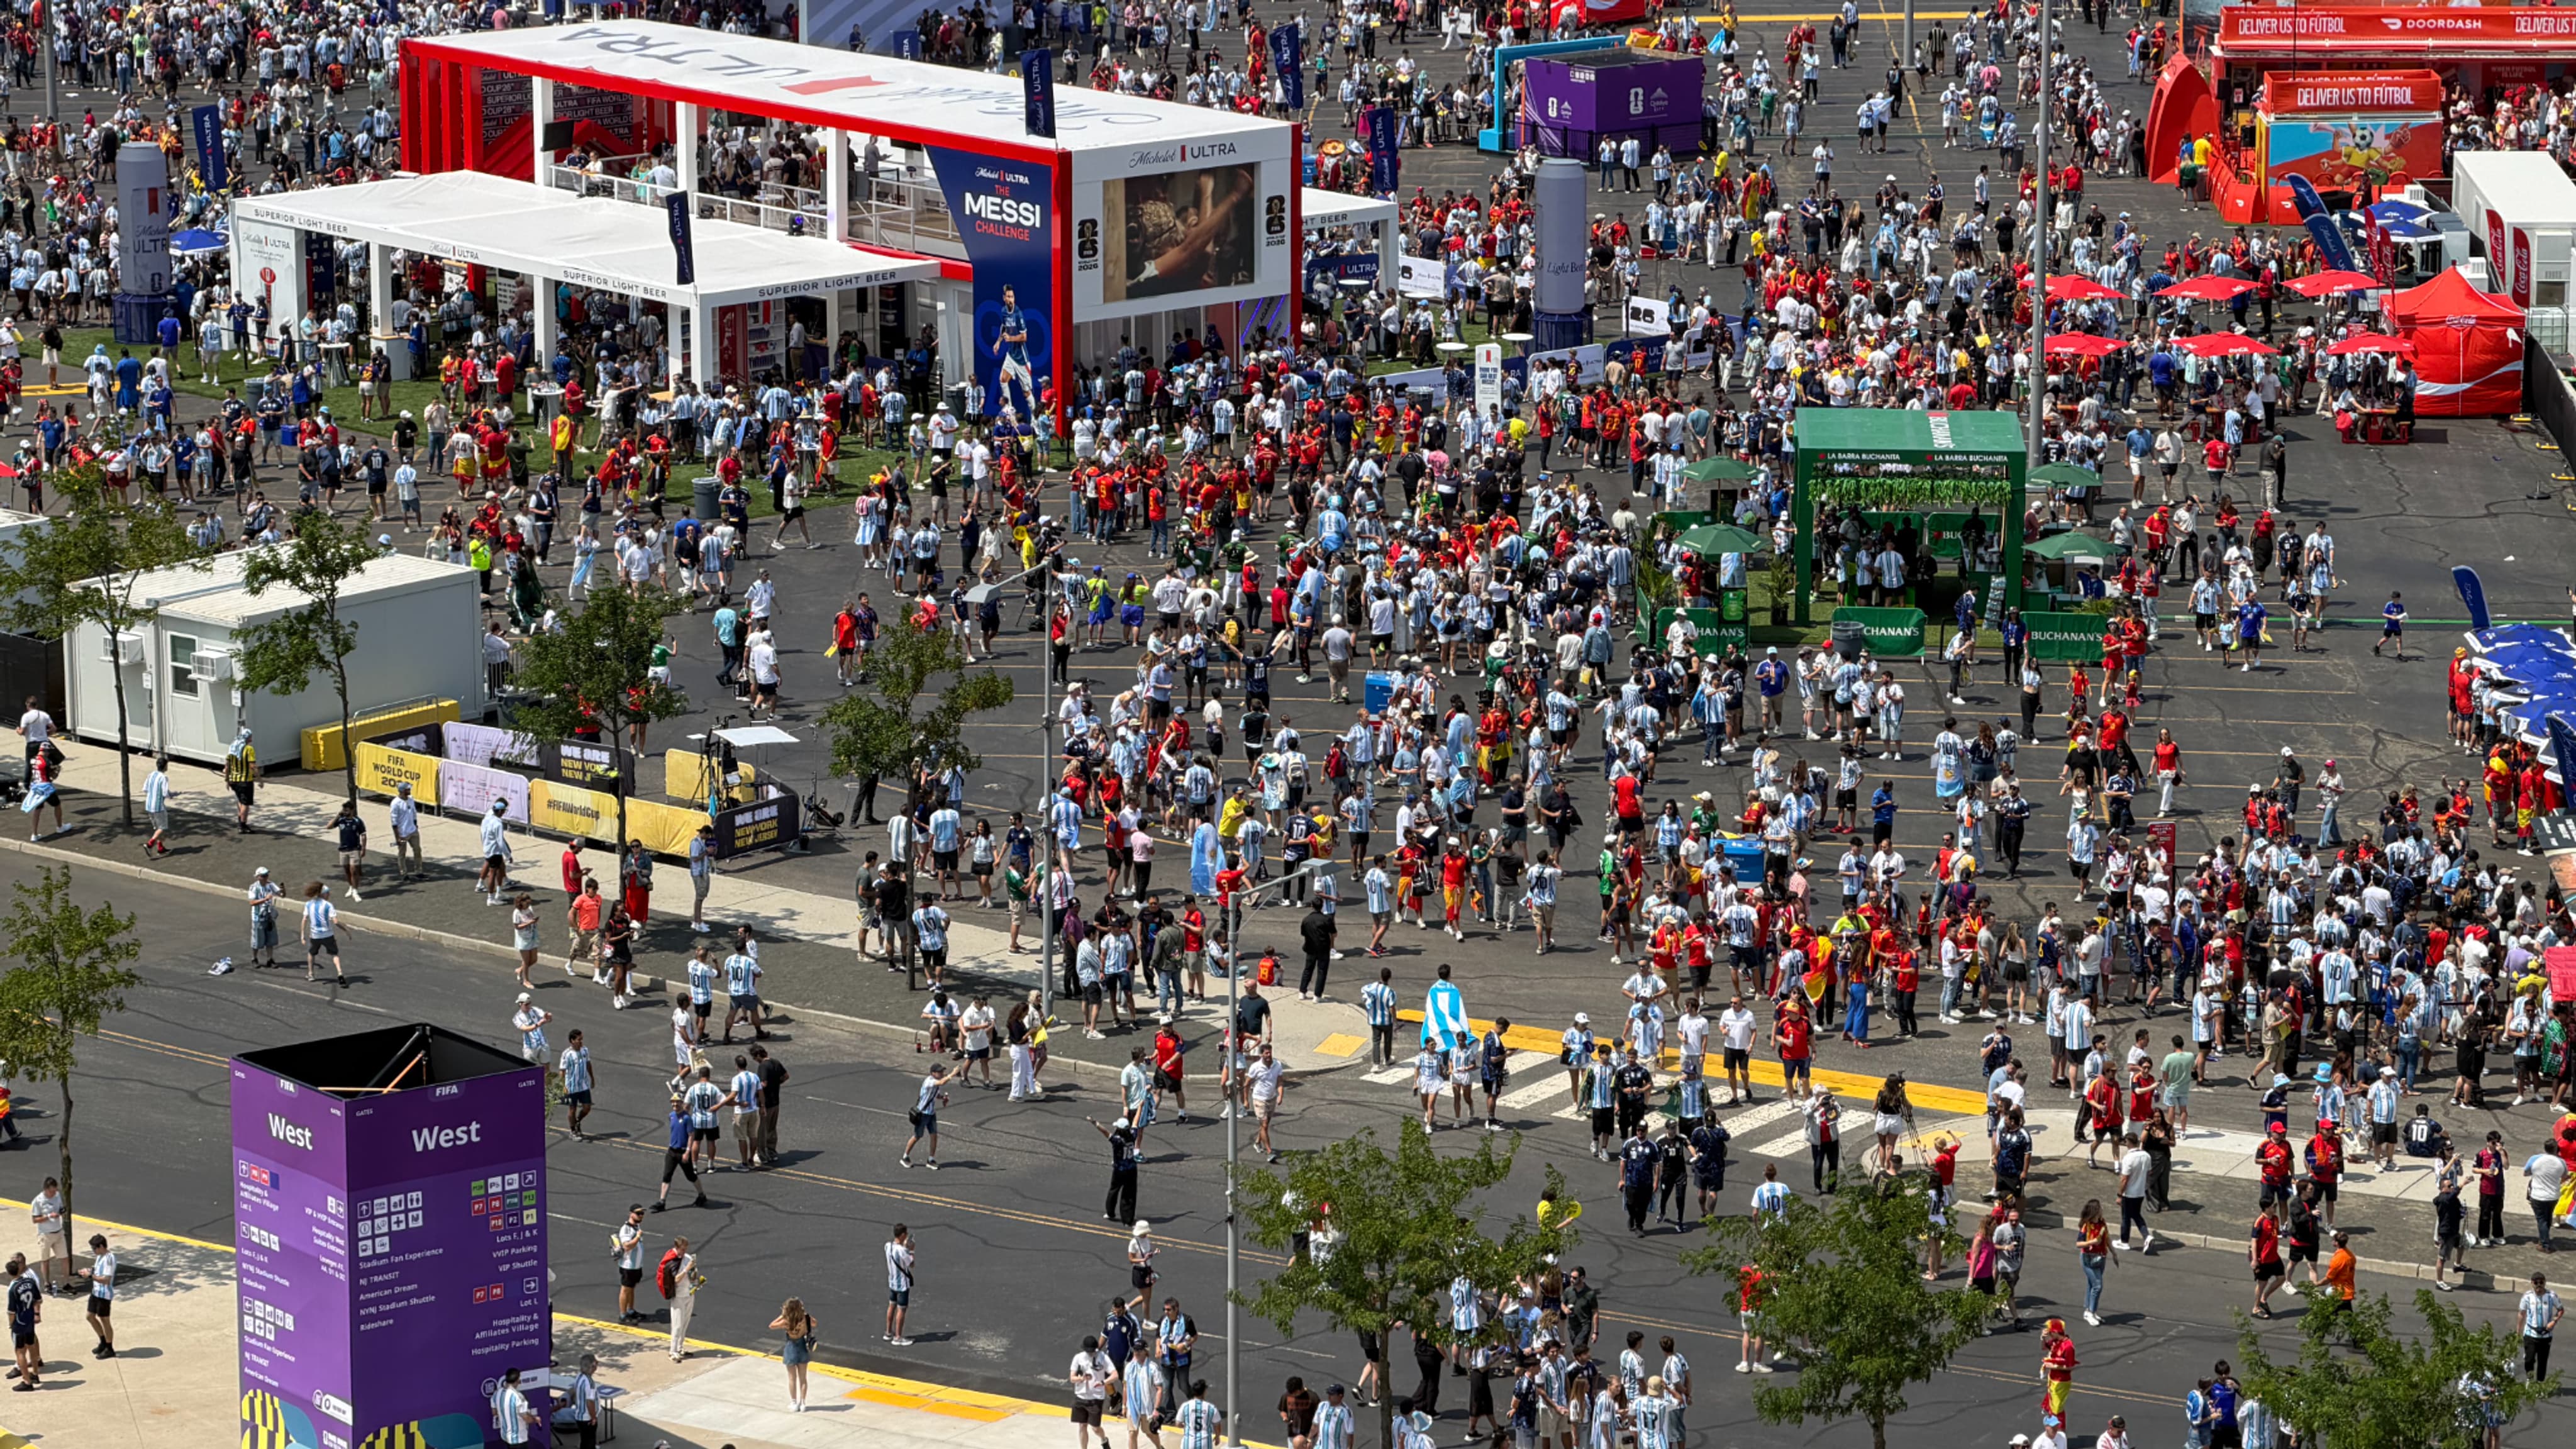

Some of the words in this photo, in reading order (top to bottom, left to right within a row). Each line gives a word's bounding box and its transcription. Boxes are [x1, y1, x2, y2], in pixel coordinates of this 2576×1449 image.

[2238, 17, 2277, 35] DELIVER
[2279, 17, 2294, 33] US
[2296, 18, 2307, 33] TO
[2309, 14, 2346, 33] FÚTBOL
[2406, 18, 2482, 29] DOORDASH
[2516, 16, 2555, 33] DELIVER
[2557, 17, 2568, 33] US
[558, 27, 811, 79] ULTRA
[1280, 32, 1291, 65] ULTRA
[1033, 58, 1041, 93] ULTRA
[487, 84, 501, 92] CUP
[2297, 87, 2340, 107] DELIVER
[2342, 87, 2355, 105] US
[2357, 87, 2371, 105] TO
[2373, 83, 2415, 105] FÚTBOL
[487, 95, 521, 104] SUPERIOR
[602, 95, 627, 103] WORLD
[574, 109, 594, 117] LIGHT
[602, 116, 628, 125] WORLD
[203, 114, 212, 146] ULTRA
[1129, 148, 1176, 169] Michelob
[1191, 143, 1236, 158] ULTRA
[1005, 174, 1030, 185] ULTRA
[995, 185, 1010, 196] THE
[964, 192, 1041, 228] MESSI
[254, 208, 295, 224] SUPERIOR
[298, 216, 323, 230] LIGHT
[326, 221, 348, 233] BEER
[675, 201, 684, 236] ULTRA
[1320, 213, 1348, 224] BEER
[975, 220, 1030, 242] CHALLENGE
[269, 239, 291, 250] ULTRA
[457, 249, 479, 260] ULTRA
[1078, 263, 1099, 271] 2026
[1347, 263, 1378, 274] ULTRA
[1547, 261, 1568, 275] Light
[564, 270, 609, 287] SUPERIOR
[612, 279, 640, 292] LIGHT
[643, 286, 667, 299] BEER
[758, 280, 819, 297] SUPERIOR
[824, 275, 861, 289] LIGHT
[866, 270, 897, 283] BEER
[1629, 308, 1655, 323] 26
[889, 400, 899, 411] 10
[1604, 418, 1621, 431] 22
[454, 441, 468, 453] 44
[370, 456, 382, 469] 10
[1861, 453, 1900, 461] BUCHANITA
[1968, 455, 2008, 463] BUCHANITA
[2049, 449, 2057, 462] 5
[921, 540, 931, 552] 10
[1547, 577, 1558, 591] 10
[2031, 631, 2102, 643] BUCHANAN'S
[560, 745, 580, 757] WE
[582, 748, 610, 763] ARE
[1941, 741, 1953, 755] 10
[2003, 741, 2016, 754] 22
[387, 755, 405, 767] FIFA
[561, 758, 582, 770] NEW
[372, 762, 403, 778] WORLD
[404, 770, 421, 781] CUP
[561, 769, 584, 780] NEW
[1194, 777, 1206, 791] 19
[547, 799, 600, 819] #FIFAWorldCup
[735, 810, 753, 826] WE
[735, 826, 755, 838] NEW
[755, 819, 779, 831] YORK
[1292, 824, 1306, 838] 10
[735, 837, 754, 848] NEW
[1250, 831, 1260, 845] 10
[1367, 880, 1376, 894] 10
[1733, 918, 1746, 933] 10
[730, 966, 743, 982] 10
[2330, 965, 2343, 981] 10
[2372, 975, 2380, 991] 11
[280, 1079, 295, 1092] FIFA
[436, 1085, 458, 1097] FIFA
[518, 1080, 535, 1088] GATES
[696, 1094, 711, 1109] 10
[356, 1108, 374, 1117] GATES
[269, 1113, 313, 1150] West
[411, 1120, 481, 1152] West
[2411, 1123, 2428, 1142] 10
[240, 1182, 264, 1197] Hospitality
[240, 1191, 262, 1204] Affiliates
[263, 1199, 279, 1211] Village
[1765, 1195, 1781, 1212] 10
[312, 1226, 335, 1242] Hospitality
[497, 1235, 511, 1243] Lots
[359, 1259, 389, 1269] Stadium
[391, 1253, 404, 1262] Fan
[405, 1248, 443, 1260] Experience
[492, 1249, 509, 1258] VVIP
[511, 1245, 538, 1255] Parking
[512, 1260, 538, 1269] Shuttle
[256, 1267, 273, 1279] Stadium
[359, 1279, 368, 1287] NJ
[370, 1272, 400, 1283] TRANSIT
[243, 1277, 265, 1291] Rideshare
[359, 1289, 392, 1301] American
[394, 1283, 418, 1294] Dream
[359, 1306, 377, 1316] NYNJ
[379, 1299, 408, 1311] Stadium
[409, 1294, 436, 1306] Shuttle
[520, 1299, 533, 1307] Lot
[360, 1319, 394, 1331] Rideshare
[493, 1314, 531, 1327] Hospitality
[475, 1328, 509, 1340] Affiliates
[511, 1323, 539, 1333] Village
[244, 1335, 264, 1348] Stadium
[272, 1346, 296, 1362] Experience
[472, 1342, 509, 1355] Hospitality
[511, 1338, 539, 1348] Parking
[251, 1353, 269, 1367] TRANSIT
[244, 1367, 264, 1381] American
[264, 1375, 279, 1387] Dream
[1194, 1416, 1202, 1432] 5
